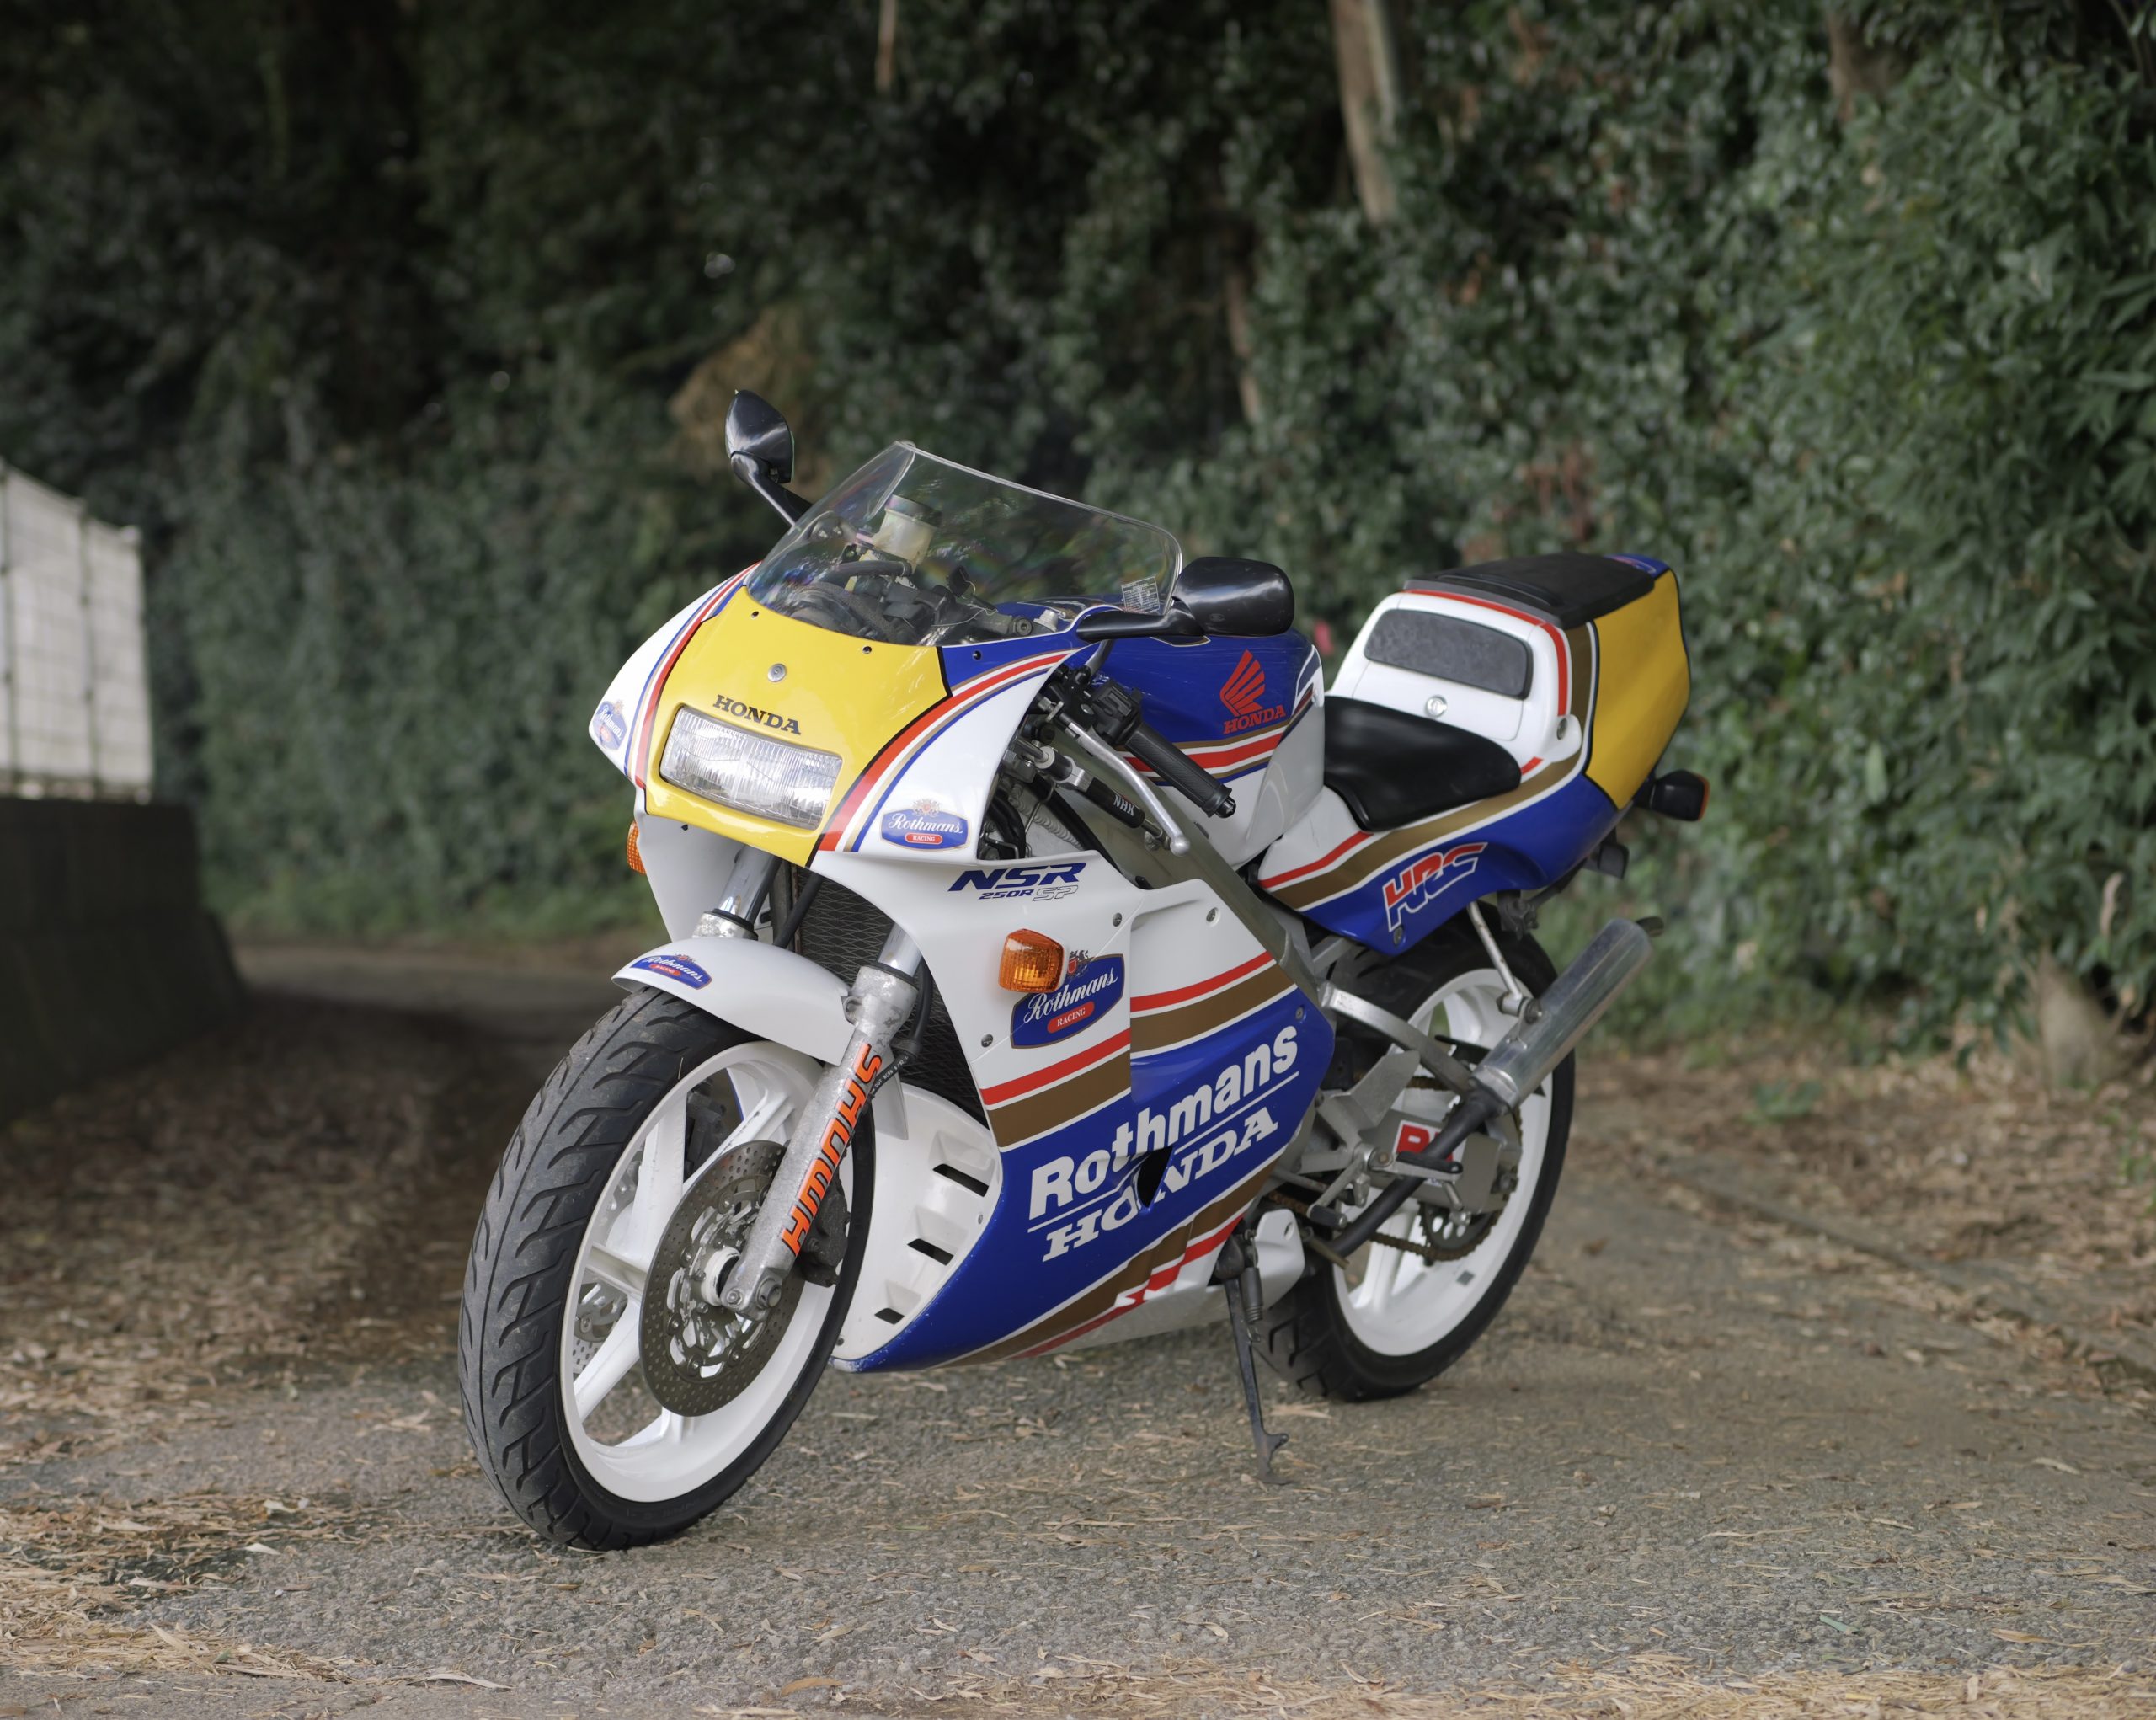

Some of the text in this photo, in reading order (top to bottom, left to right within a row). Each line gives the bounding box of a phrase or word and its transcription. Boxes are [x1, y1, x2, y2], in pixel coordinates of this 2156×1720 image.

[712, 694, 802, 735] HONDA
[1223, 704, 1286, 735] HONDA
[1113, 794, 1135, 816] NHK
[889, 813, 963, 834] Rothmans
[912, 834, 937, 842] RACING
[947, 862, 1086, 892] NSR
[978, 884, 1079, 901] 250R SP
[1023, 967, 1118, 1024] Rothmans
[1056, 1007, 1086, 1028] RACING
[1029, 1025, 1299, 1221] Rothmans
[780, 1041, 883, 1257] SHOWA
[1043, 1106, 1279, 1263] HONDA
